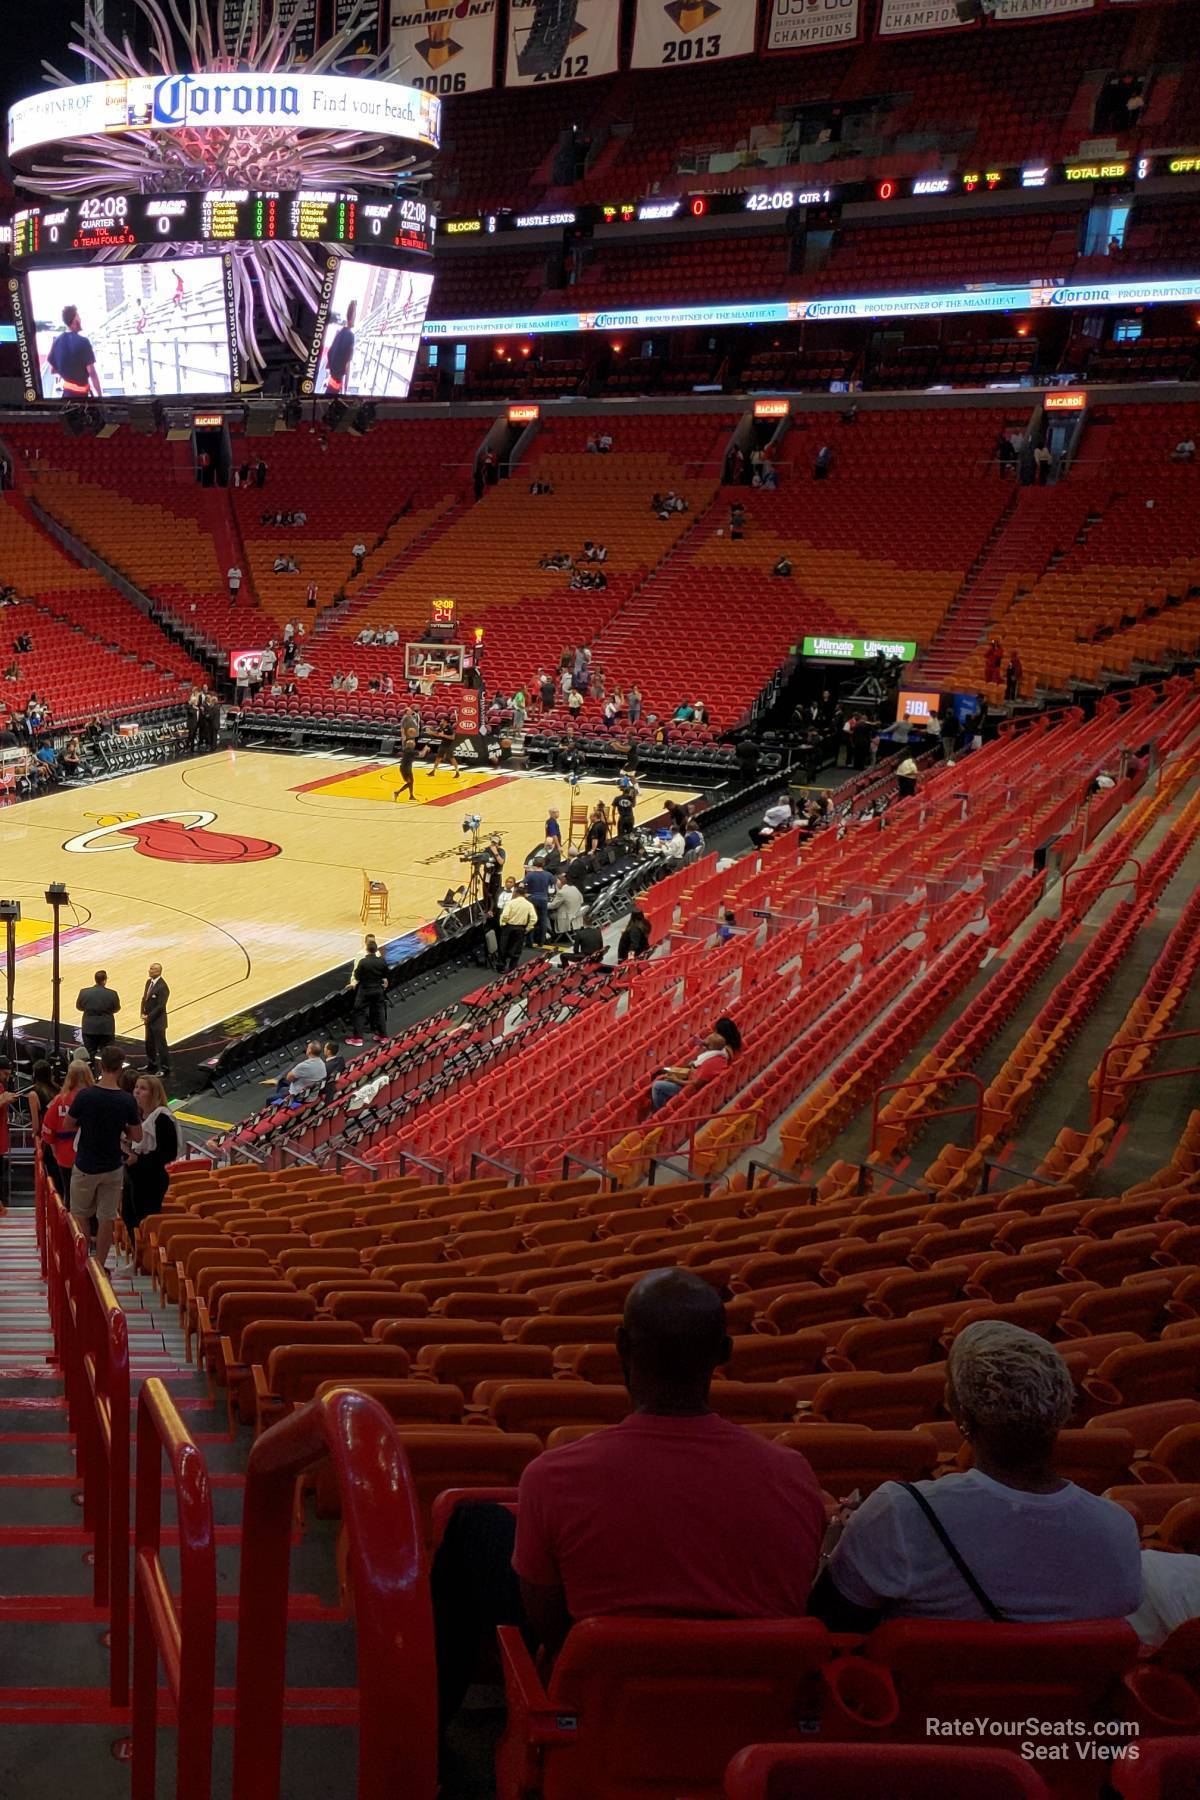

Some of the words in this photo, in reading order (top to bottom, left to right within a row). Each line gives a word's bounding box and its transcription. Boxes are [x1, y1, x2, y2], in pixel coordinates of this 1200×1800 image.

[885, 9, 960, 28] CHAMPION
[774, 22, 852, 43] CHAMPIONS
[662, 35, 721, 63] 2013
[153, 74, 300, 127] Corona
[313, 90, 346, 111] Find
[1066, 168, 1099, 180] TOTAL
[1101, 165, 1125, 177] REB
[1170, 160, 1194, 172] OFF
[880, 183, 891, 199] 0
[913, 180, 949, 194] MAGIC
[79, 197, 128, 218] 42:08
[693, 200, 704, 215] 0
[746, 191, 793, 211] 42:08
[798, 193, 820, 204] QTR
[823, 191, 830, 202] 1
[400, 200, 426, 222] 42:08
[81, 219, 114, 229] QUARTER
[158, 217, 170, 234] 0
[372, 219, 381, 236] 0
[448, 221, 481, 233] BLOCKS
[517, 215, 549, 227] HUSTLE
[549, 213, 575, 224] STATS
[50, 226, 58, 242] 0
[82, 237, 100, 246] TEAM
[100, 235, 125, 245] FOULS
[1051, 288, 1110, 305] Corona
[1118, 289, 1151, 299] PROUD
[1153, 287, 1192, 298] PARTNER
[806, 303, 856, 318] Corona
[864, 304, 893, 312] PROUD
[894, 302, 930, 311] PARTNER
[931, 301, 943, 309] OF
[947, 300, 963, 308] THE
[964, 299, 991, 307] MIAMI
[992, 297, 1016, 305] HEAT
[226, 270, 240, 377] MICCOSUKEE.COM
[306, 272, 336, 379] MICCOSUKEE.COM
[594, 313, 639, 328] Corona
[645, 315, 667, 323] PROUD
[671, 313, 702, 322] PARTNER
[703, 312, 714, 320] OF
[716, 312, 730, 320] THE
[731, 311, 753, 319] MIAMI
[754, 310, 775, 318] HEAT
[423, 323, 448, 334] rona
[515, 321, 529, 330] THE
[11, 292, 33, 387] MICCOSUKEE.COM
[432, 600, 454, 609] 42:08
[435, 609, 451, 621] 24
[813, 638, 854, 651] Ultimate
[864, 640, 905, 653] Ultimate
